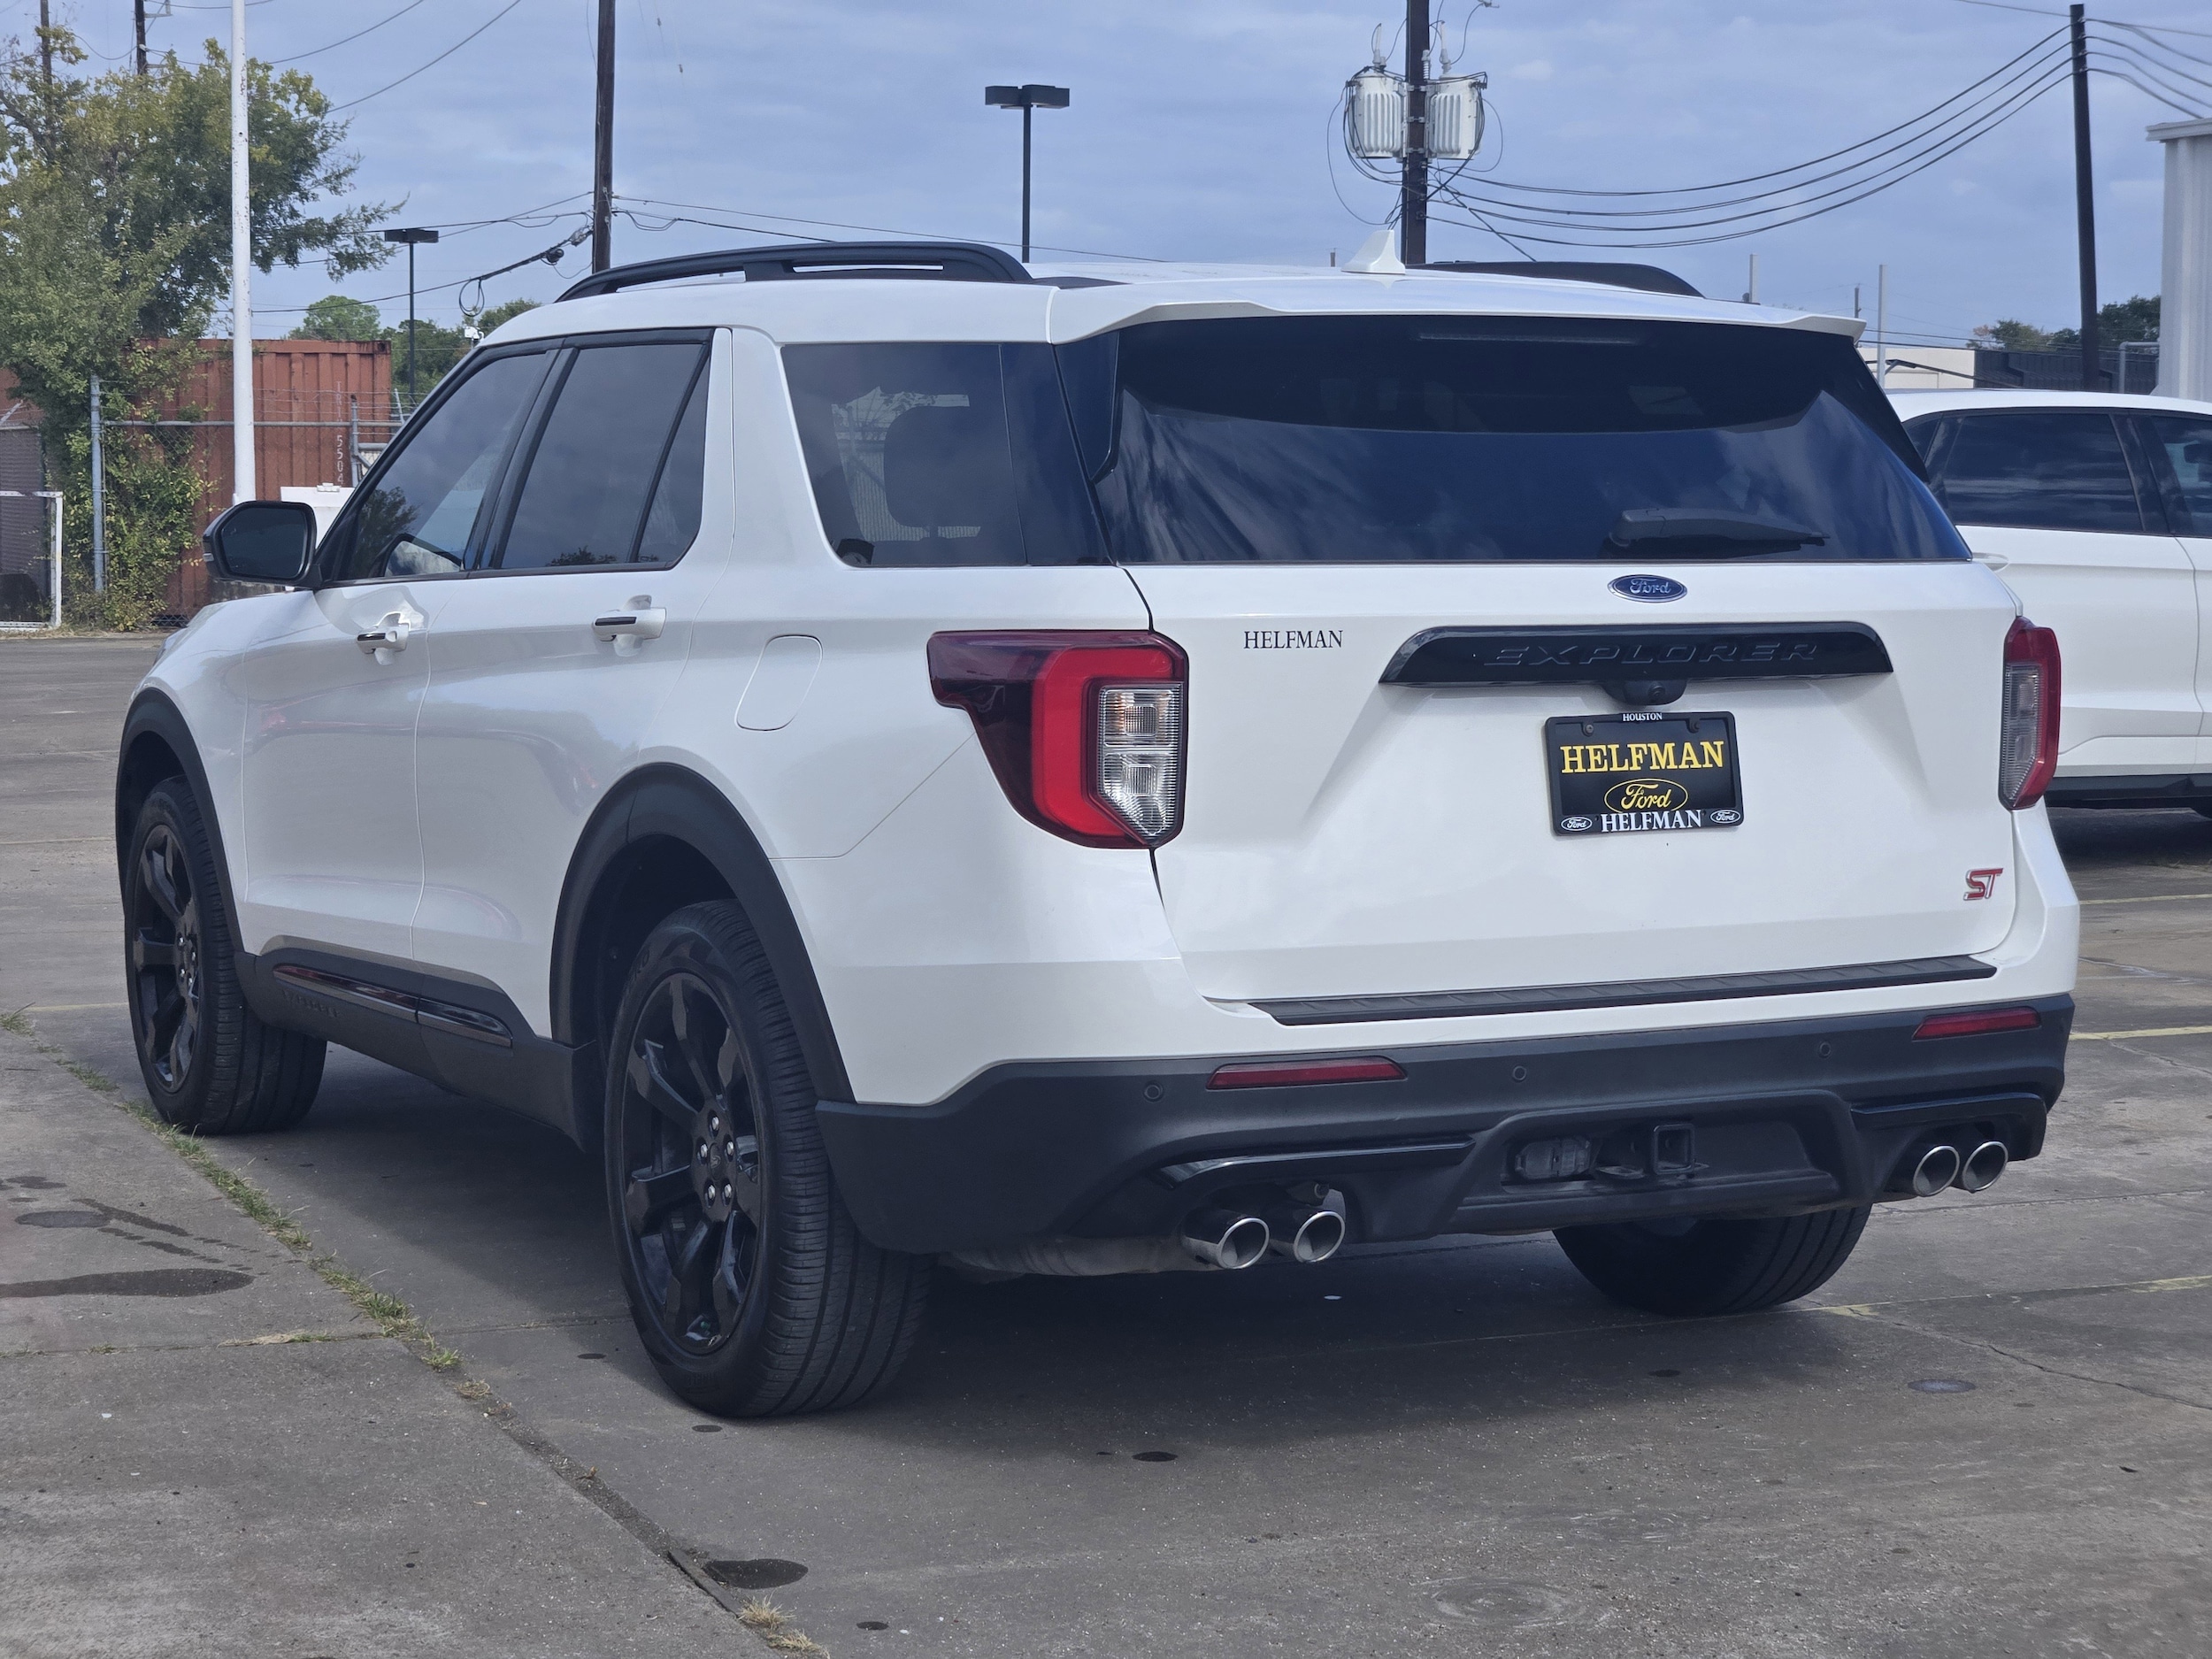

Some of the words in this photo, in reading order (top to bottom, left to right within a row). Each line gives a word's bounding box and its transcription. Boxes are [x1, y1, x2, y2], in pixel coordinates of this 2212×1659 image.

[1630, 578, 1671, 594] Ford
[1243, 630, 1343, 649] HELFMAN
[1483, 642, 1817, 665] EXPLORER
[1622, 712, 1663, 722] HOUSTON
[1560, 741, 1724, 773] HELFMAN
[1620, 783, 1672, 810] Ford
[1567, 818, 1586, 829] Ford
[1601, 810, 1702, 833] HELFMAN
[1715, 811, 1735, 822] Ford
[1963, 868, 2004, 901] ST
